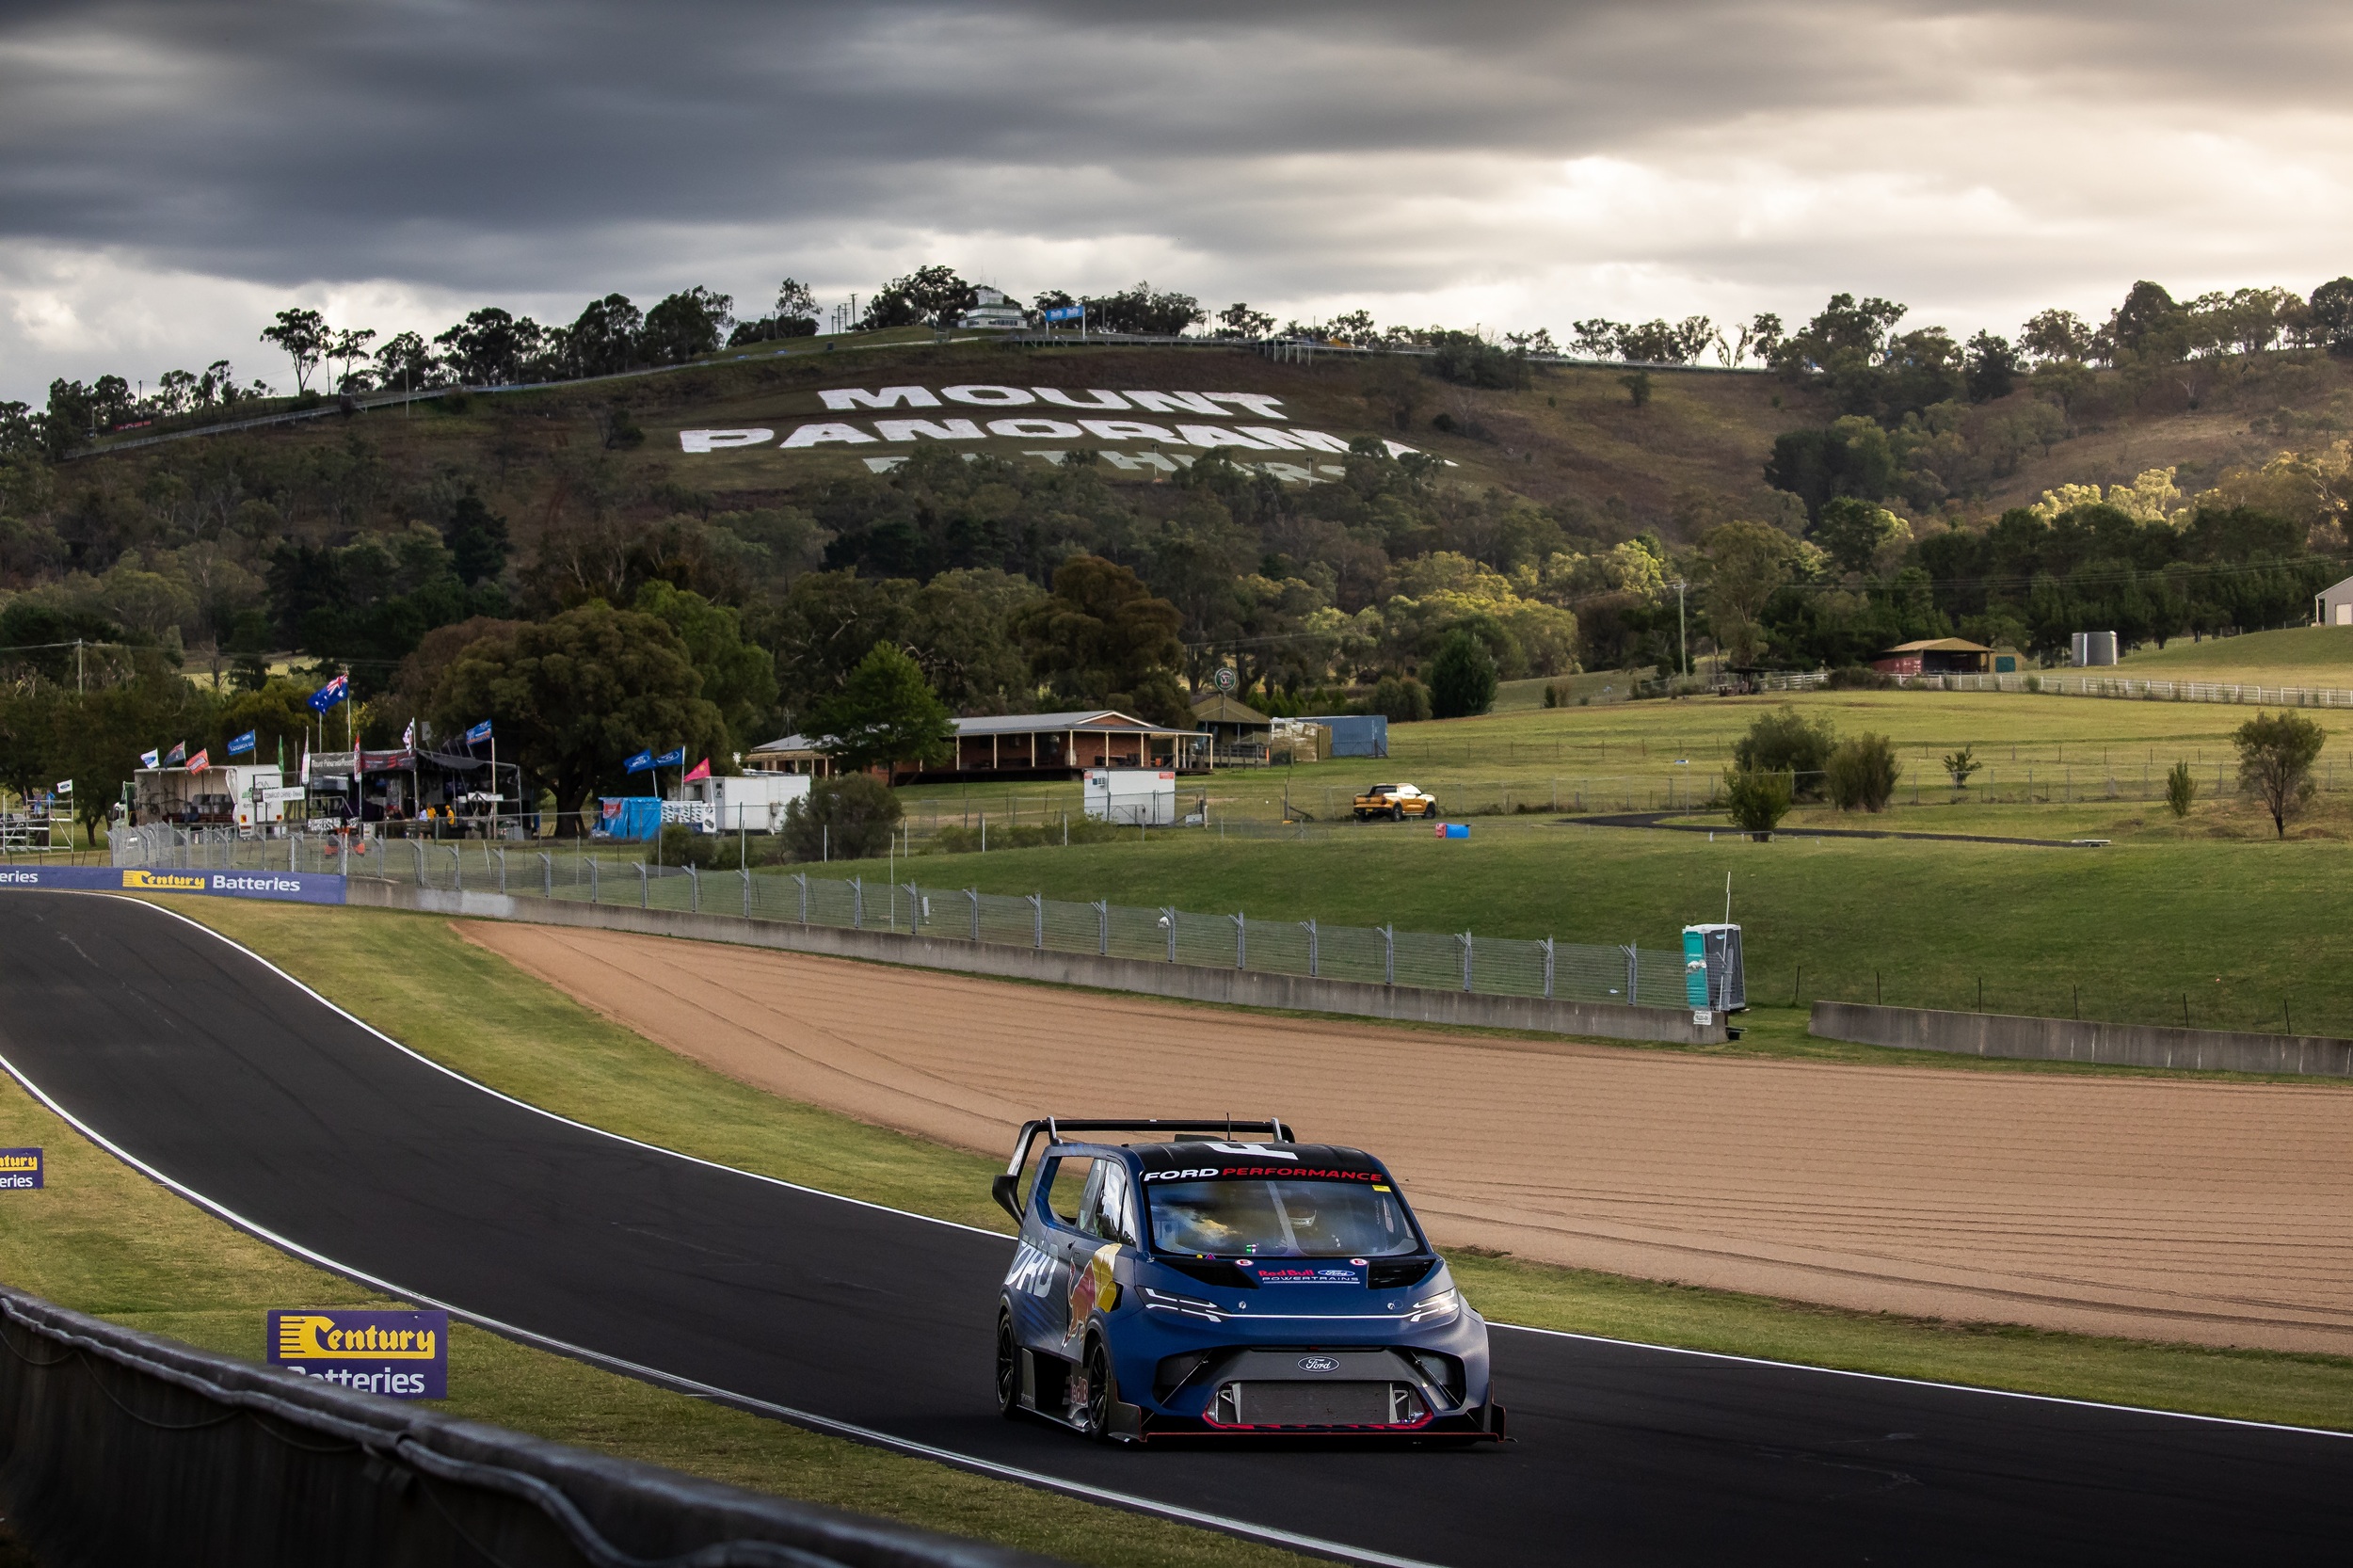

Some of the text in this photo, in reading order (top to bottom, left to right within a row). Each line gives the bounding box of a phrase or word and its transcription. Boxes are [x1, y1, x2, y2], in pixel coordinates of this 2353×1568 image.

[818, 385, 1289, 420] MOUNT
[122, 870, 301, 891] Century Batteries
[1144, 1167, 1383, 1182] FORD PERFORMANCE
[1005, 1235, 1059, 1298] ORD
[280, 1316, 435, 1359] Century
[1305, 1358, 1332, 1369] Ford
